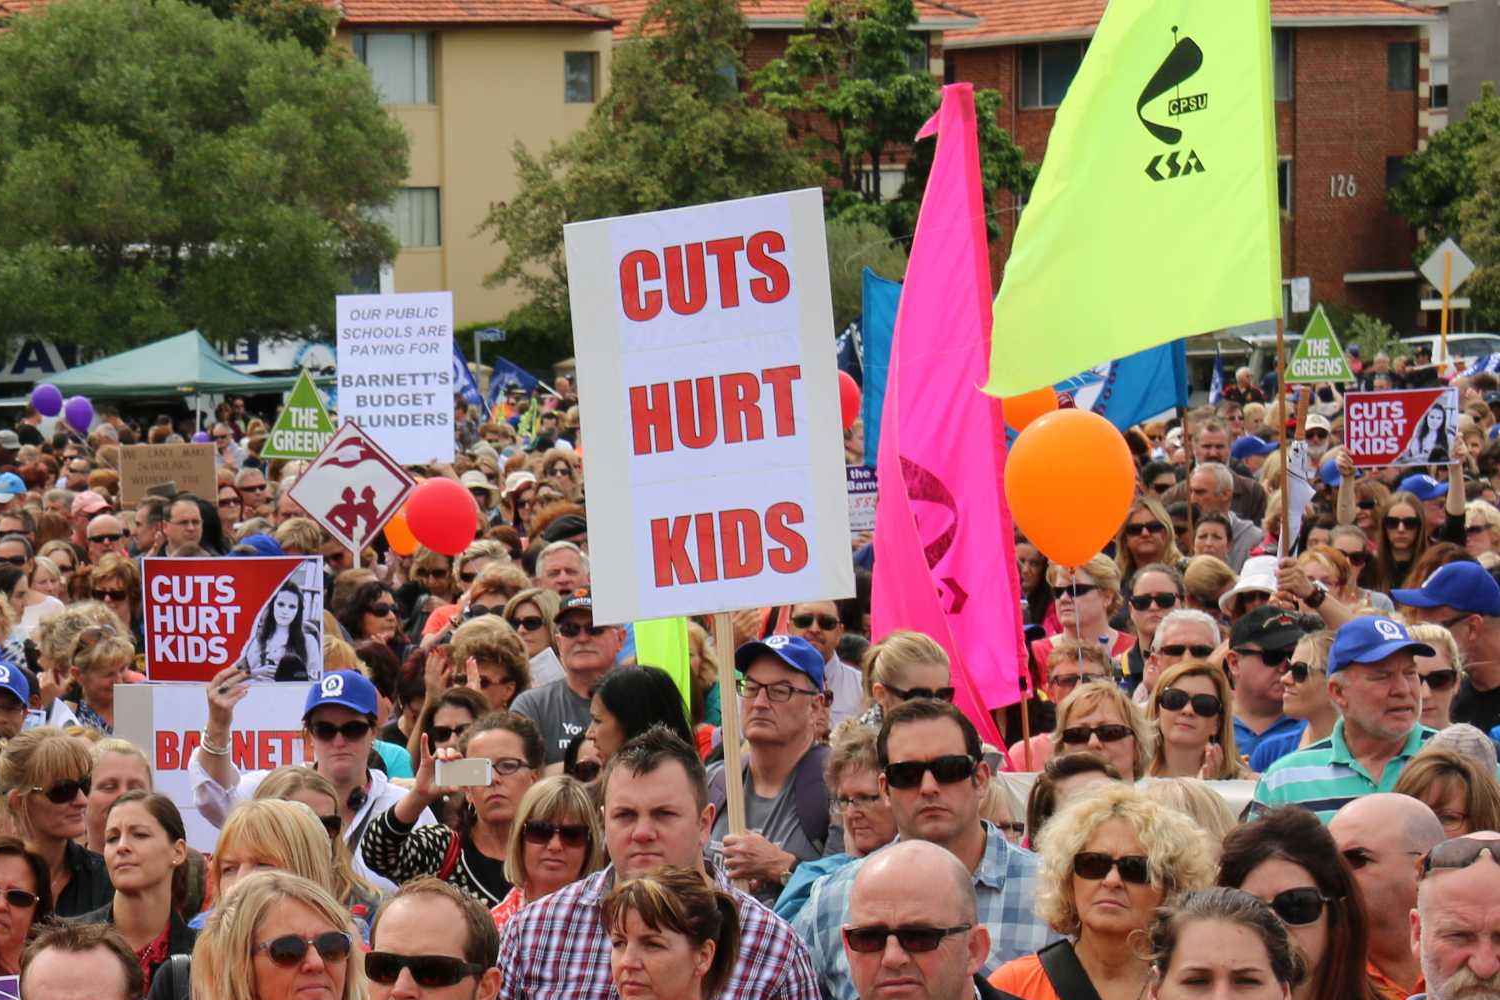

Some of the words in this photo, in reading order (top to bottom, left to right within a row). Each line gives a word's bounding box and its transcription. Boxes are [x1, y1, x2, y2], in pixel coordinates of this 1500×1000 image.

[1170, 95, 1207, 114] CPSU
[1330, 174, 1357, 197] 126
[619, 230, 791, 322] CUTS
[350, 308, 381, 320] OUR
[385, 307, 439, 319] PUBLIC
[342, 327, 412, 339] SCHOOLS
[417, 325, 447, 337] ARE
[350, 344, 405, 356] PAYING
[408, 342, 439, 354] FOR
[1306, 339, 1330, 356] THE
[1292, 359, 1342, 376] GREENS
[341, 372, 449, 387] BARNETT'S
[356, 393, 435, 408] BUDGET
[289, 407, 318, 429] THE
[629, 365, 801, 455] HURT
[1350, 401, 1404, 419] CUTS
[1350, 420, 1407, 437] HURT
[1350, 438, 1400, 456] KIDS
[850, 469, 871, 479] the
[651, 502, 809, 587] KIDS
[151, 575, 235, 604] CUTS
[153, 605, 241, 634] HURT
[154, 635, 229, 665] KIDS
[156, 730, 308, 770] BANET
